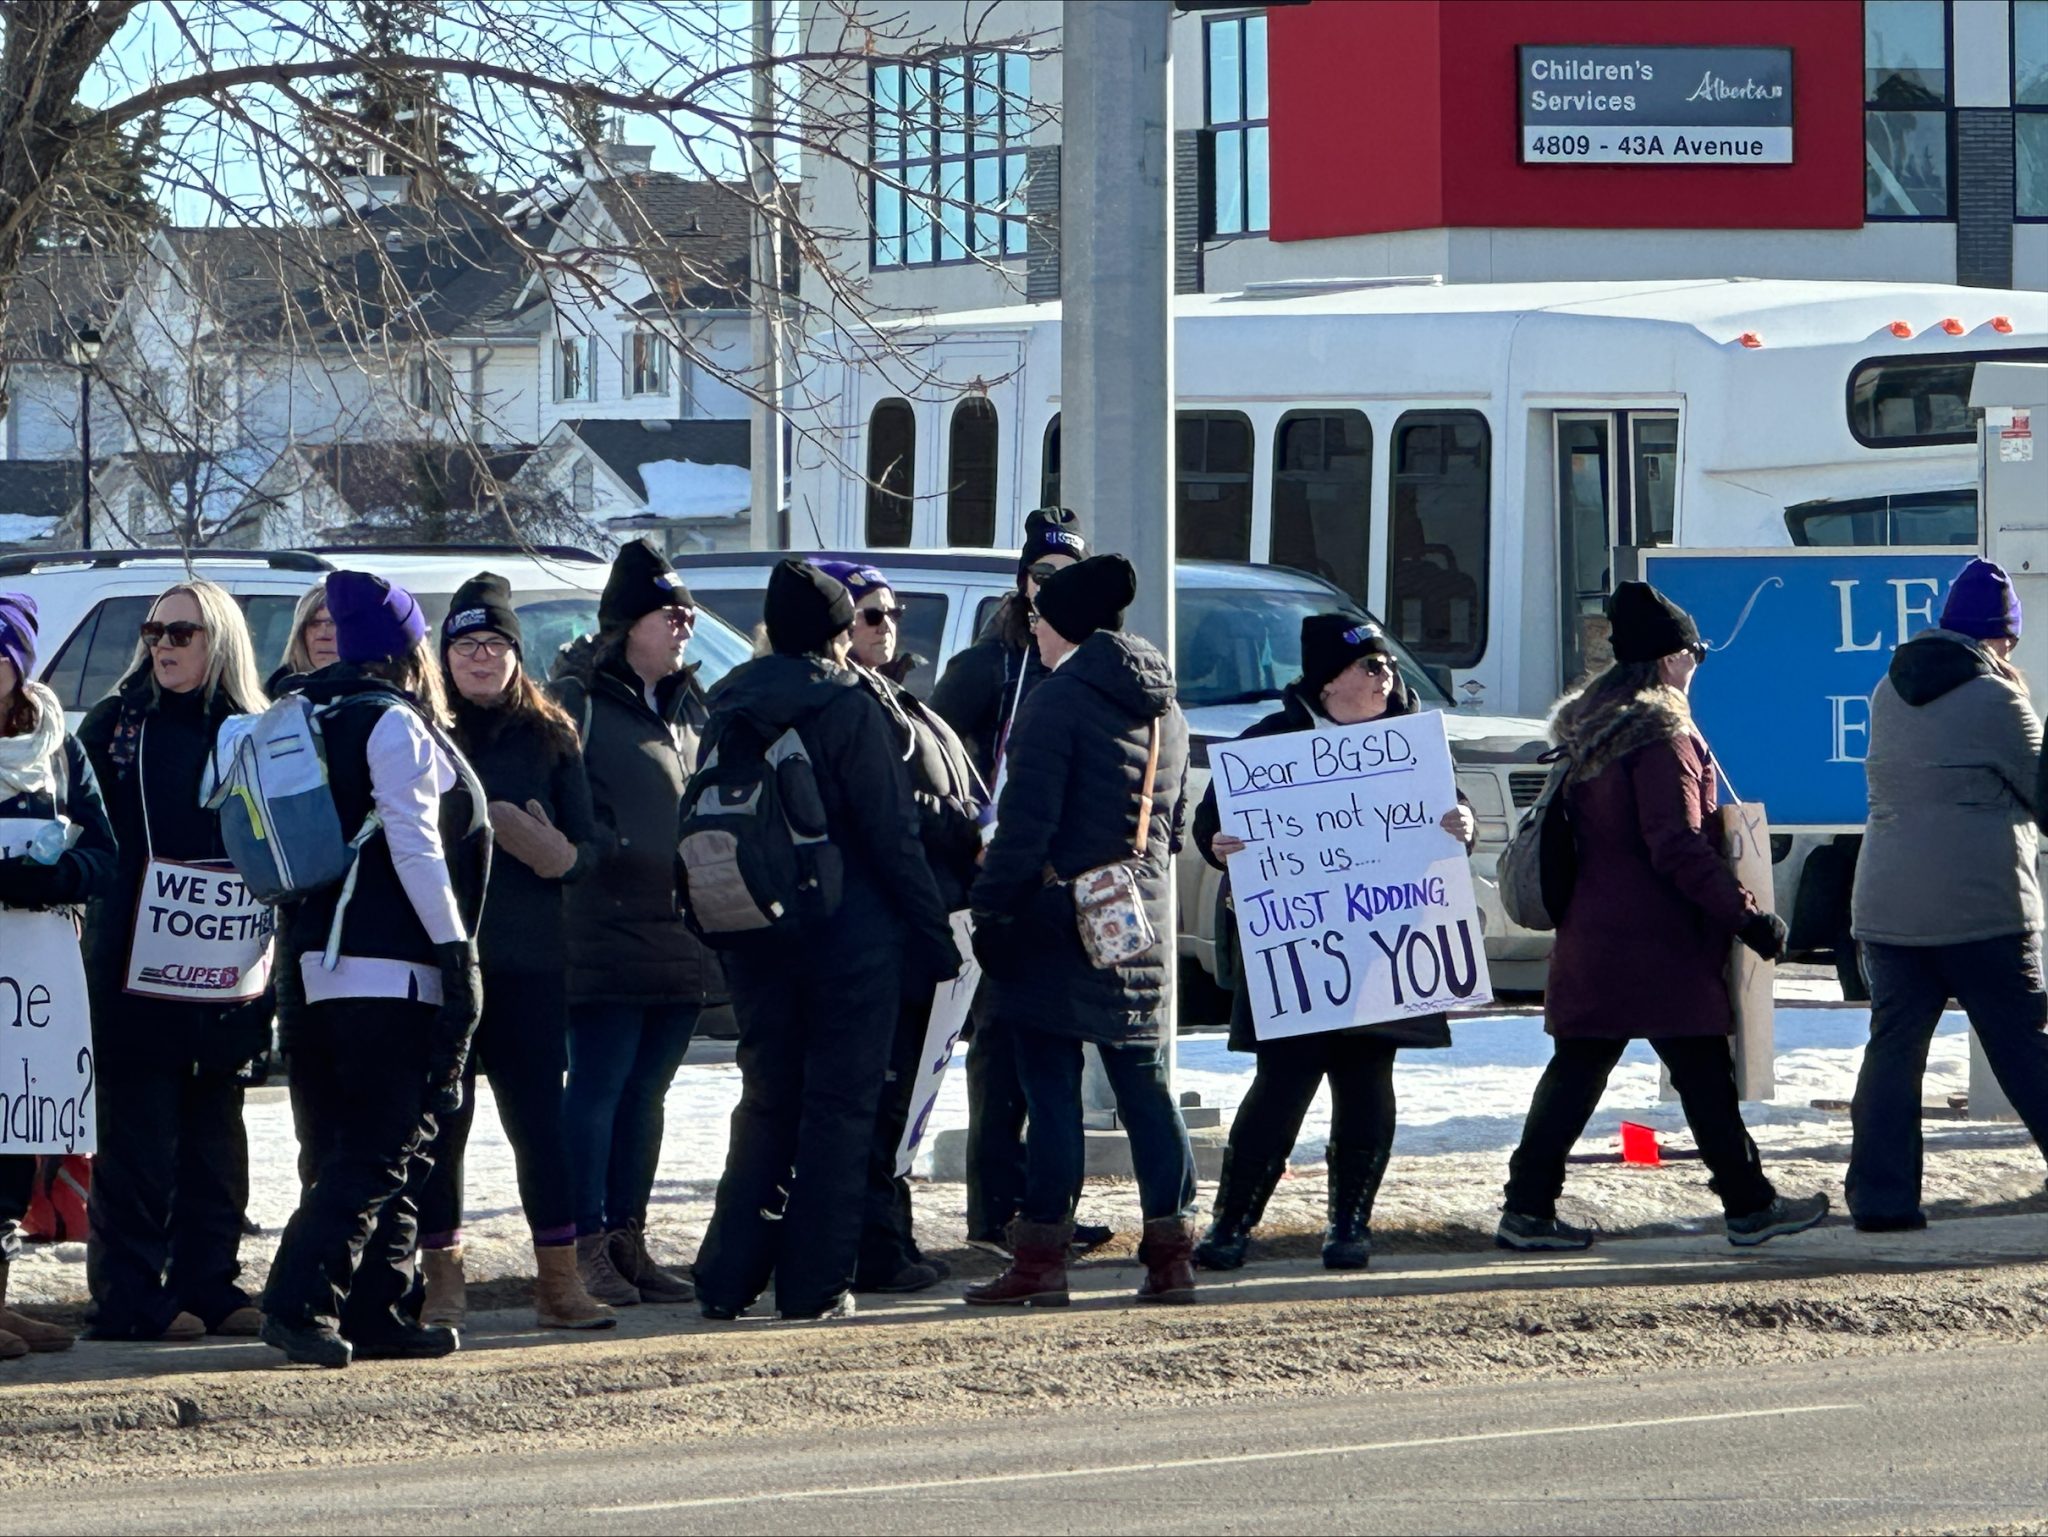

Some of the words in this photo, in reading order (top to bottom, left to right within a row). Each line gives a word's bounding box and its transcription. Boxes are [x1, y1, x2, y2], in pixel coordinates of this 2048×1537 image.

[1531, 60, 1653, 80] Children's
[1685, 71, 1774, 101] Alberta
[1531, 90, 1636, 111] Services
[1532, 135, 1590, 155] 4809
[1617, 135, 1664, 155] 43A
[1673, 135, 1763, 155] Avenue
[1830, 578, 1958, 652] LE
[1220, 751, 1298, 793] Dear
[1312, 729, 1418, 778] BGSD,
[1233, 808, 1304, 843] It's
[1316, 792, 1365, 832] not
[1259, 846, 1305, 881] it's
[156, 870, 207, 905] WE
[215, 880, 257, 907] ST
[1243, 888, 1330, 937] JUST
[161, 964, 222, 985] CUPE
[1256, 929, 1352, 1019] IT'S
[1369, 919, 1478, 1006] YOU
